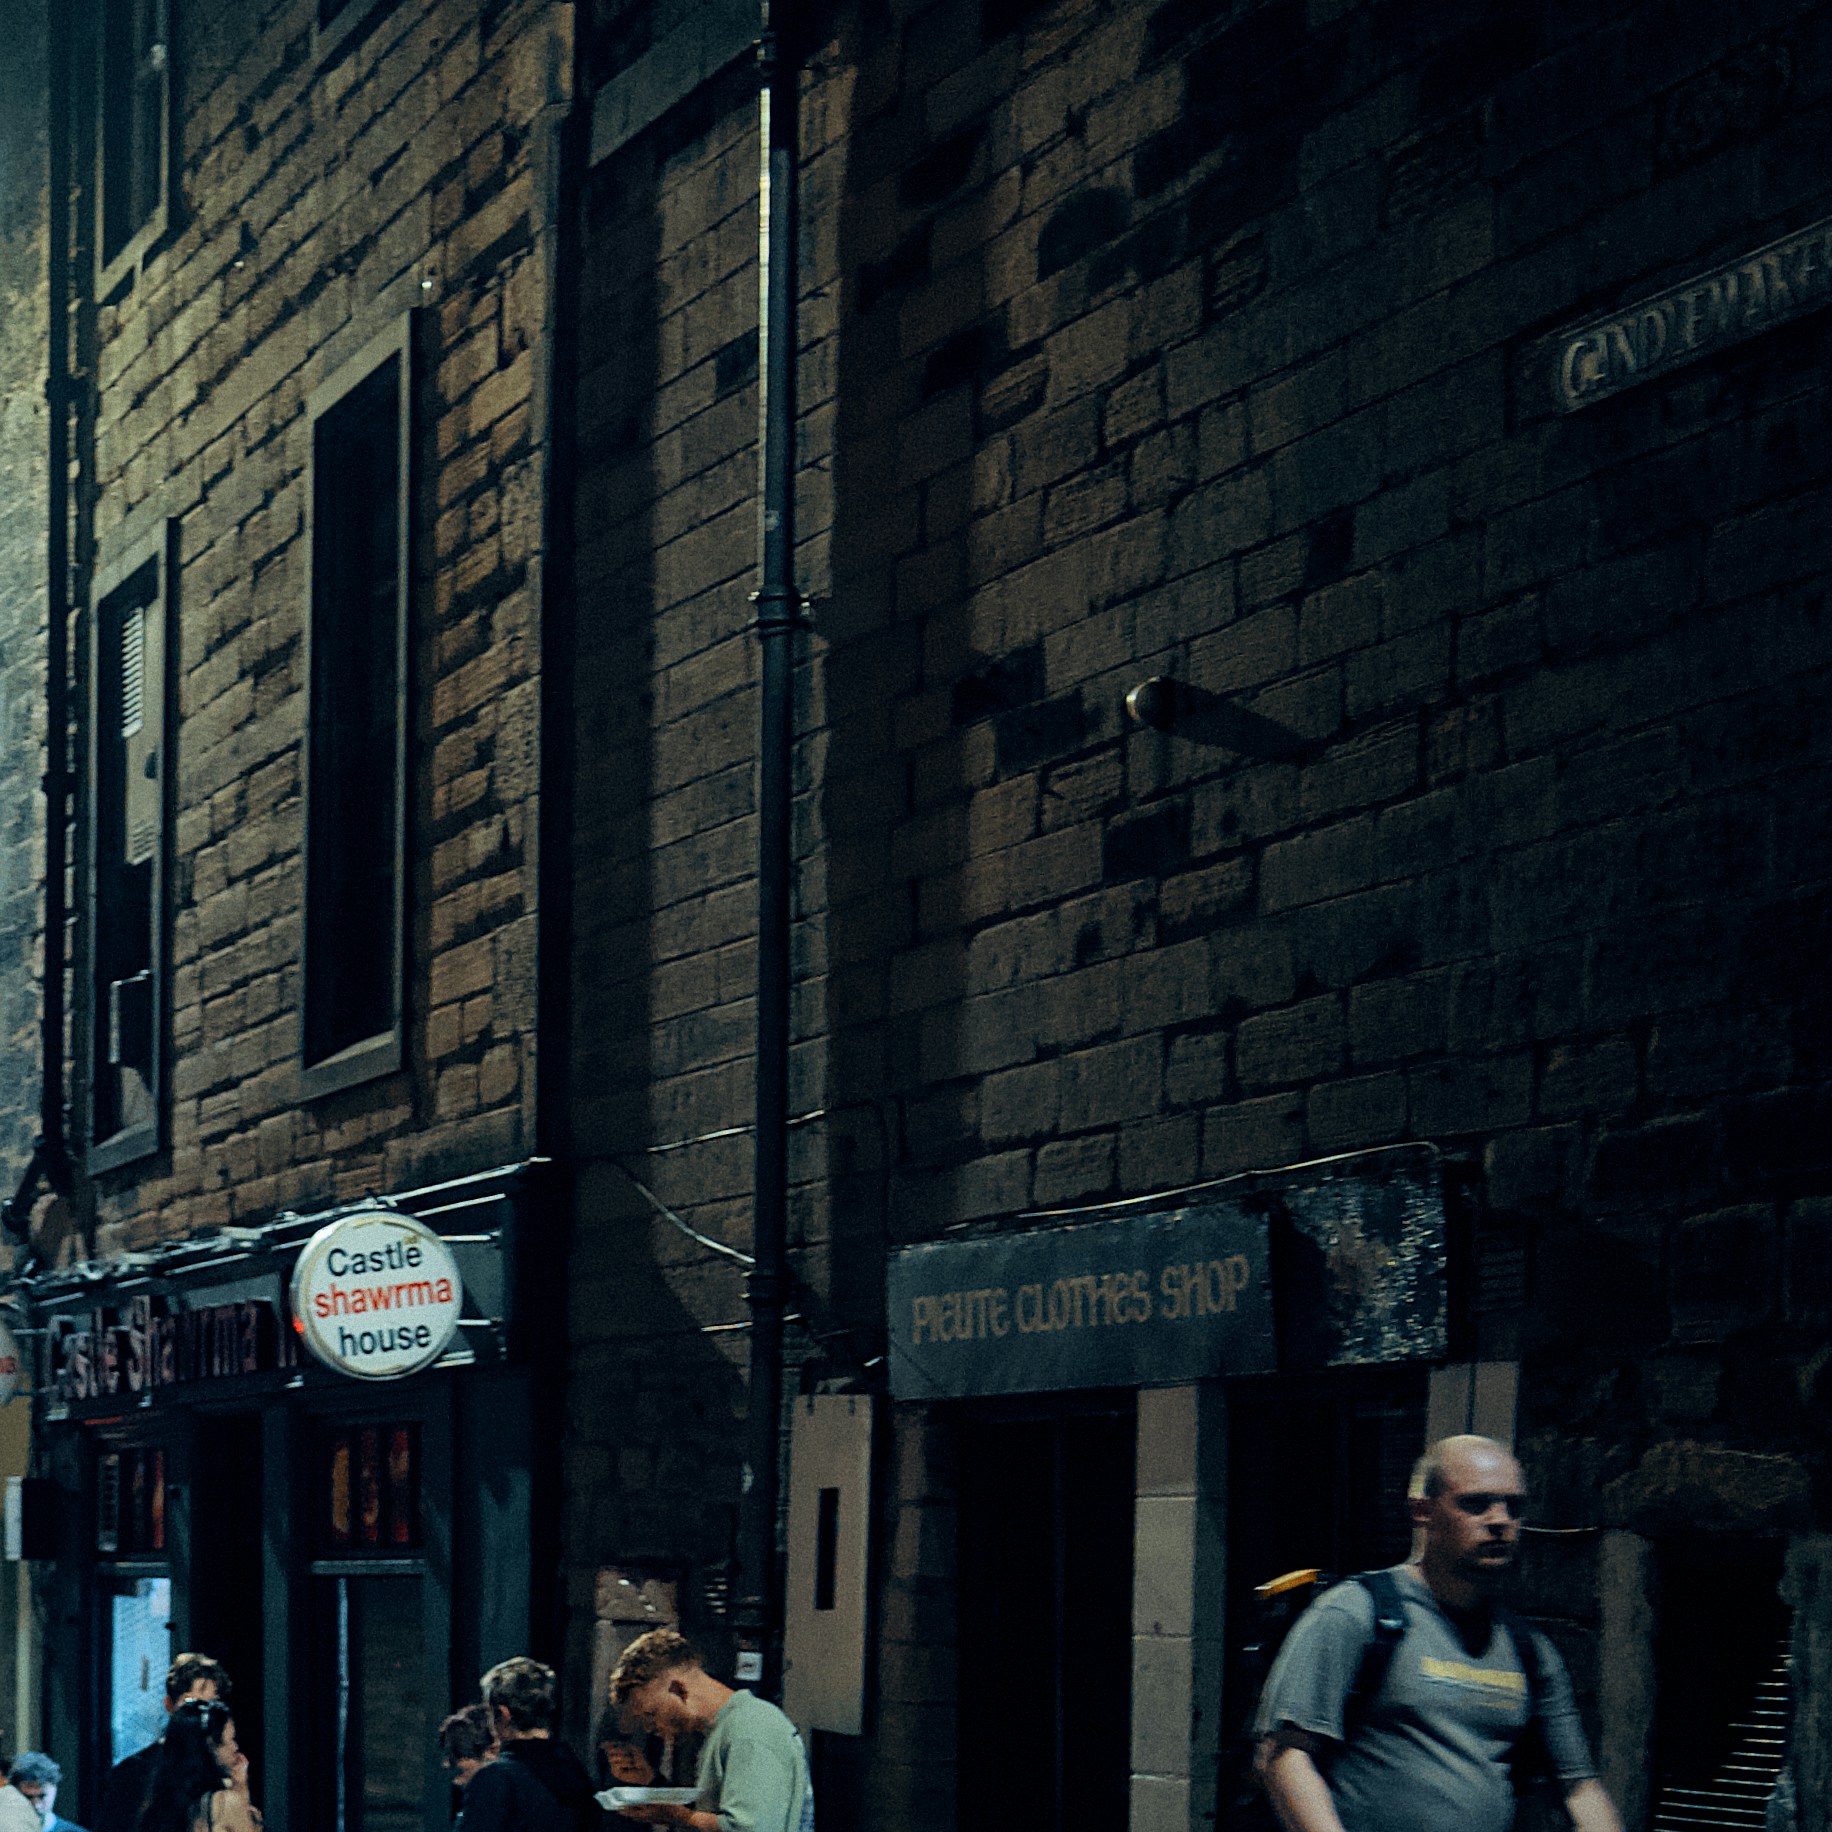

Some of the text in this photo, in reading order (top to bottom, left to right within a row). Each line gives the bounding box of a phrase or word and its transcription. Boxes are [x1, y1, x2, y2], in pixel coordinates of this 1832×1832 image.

[327, 1241, 423, 1277] Castle
[314, 1278, 453, 1319] shawrma
[1016, 1270, 1153, 1334] CLOTHES
[1160, 1253, 1250, 1320] SHOP
[338, 1325, 432, 1357] house
